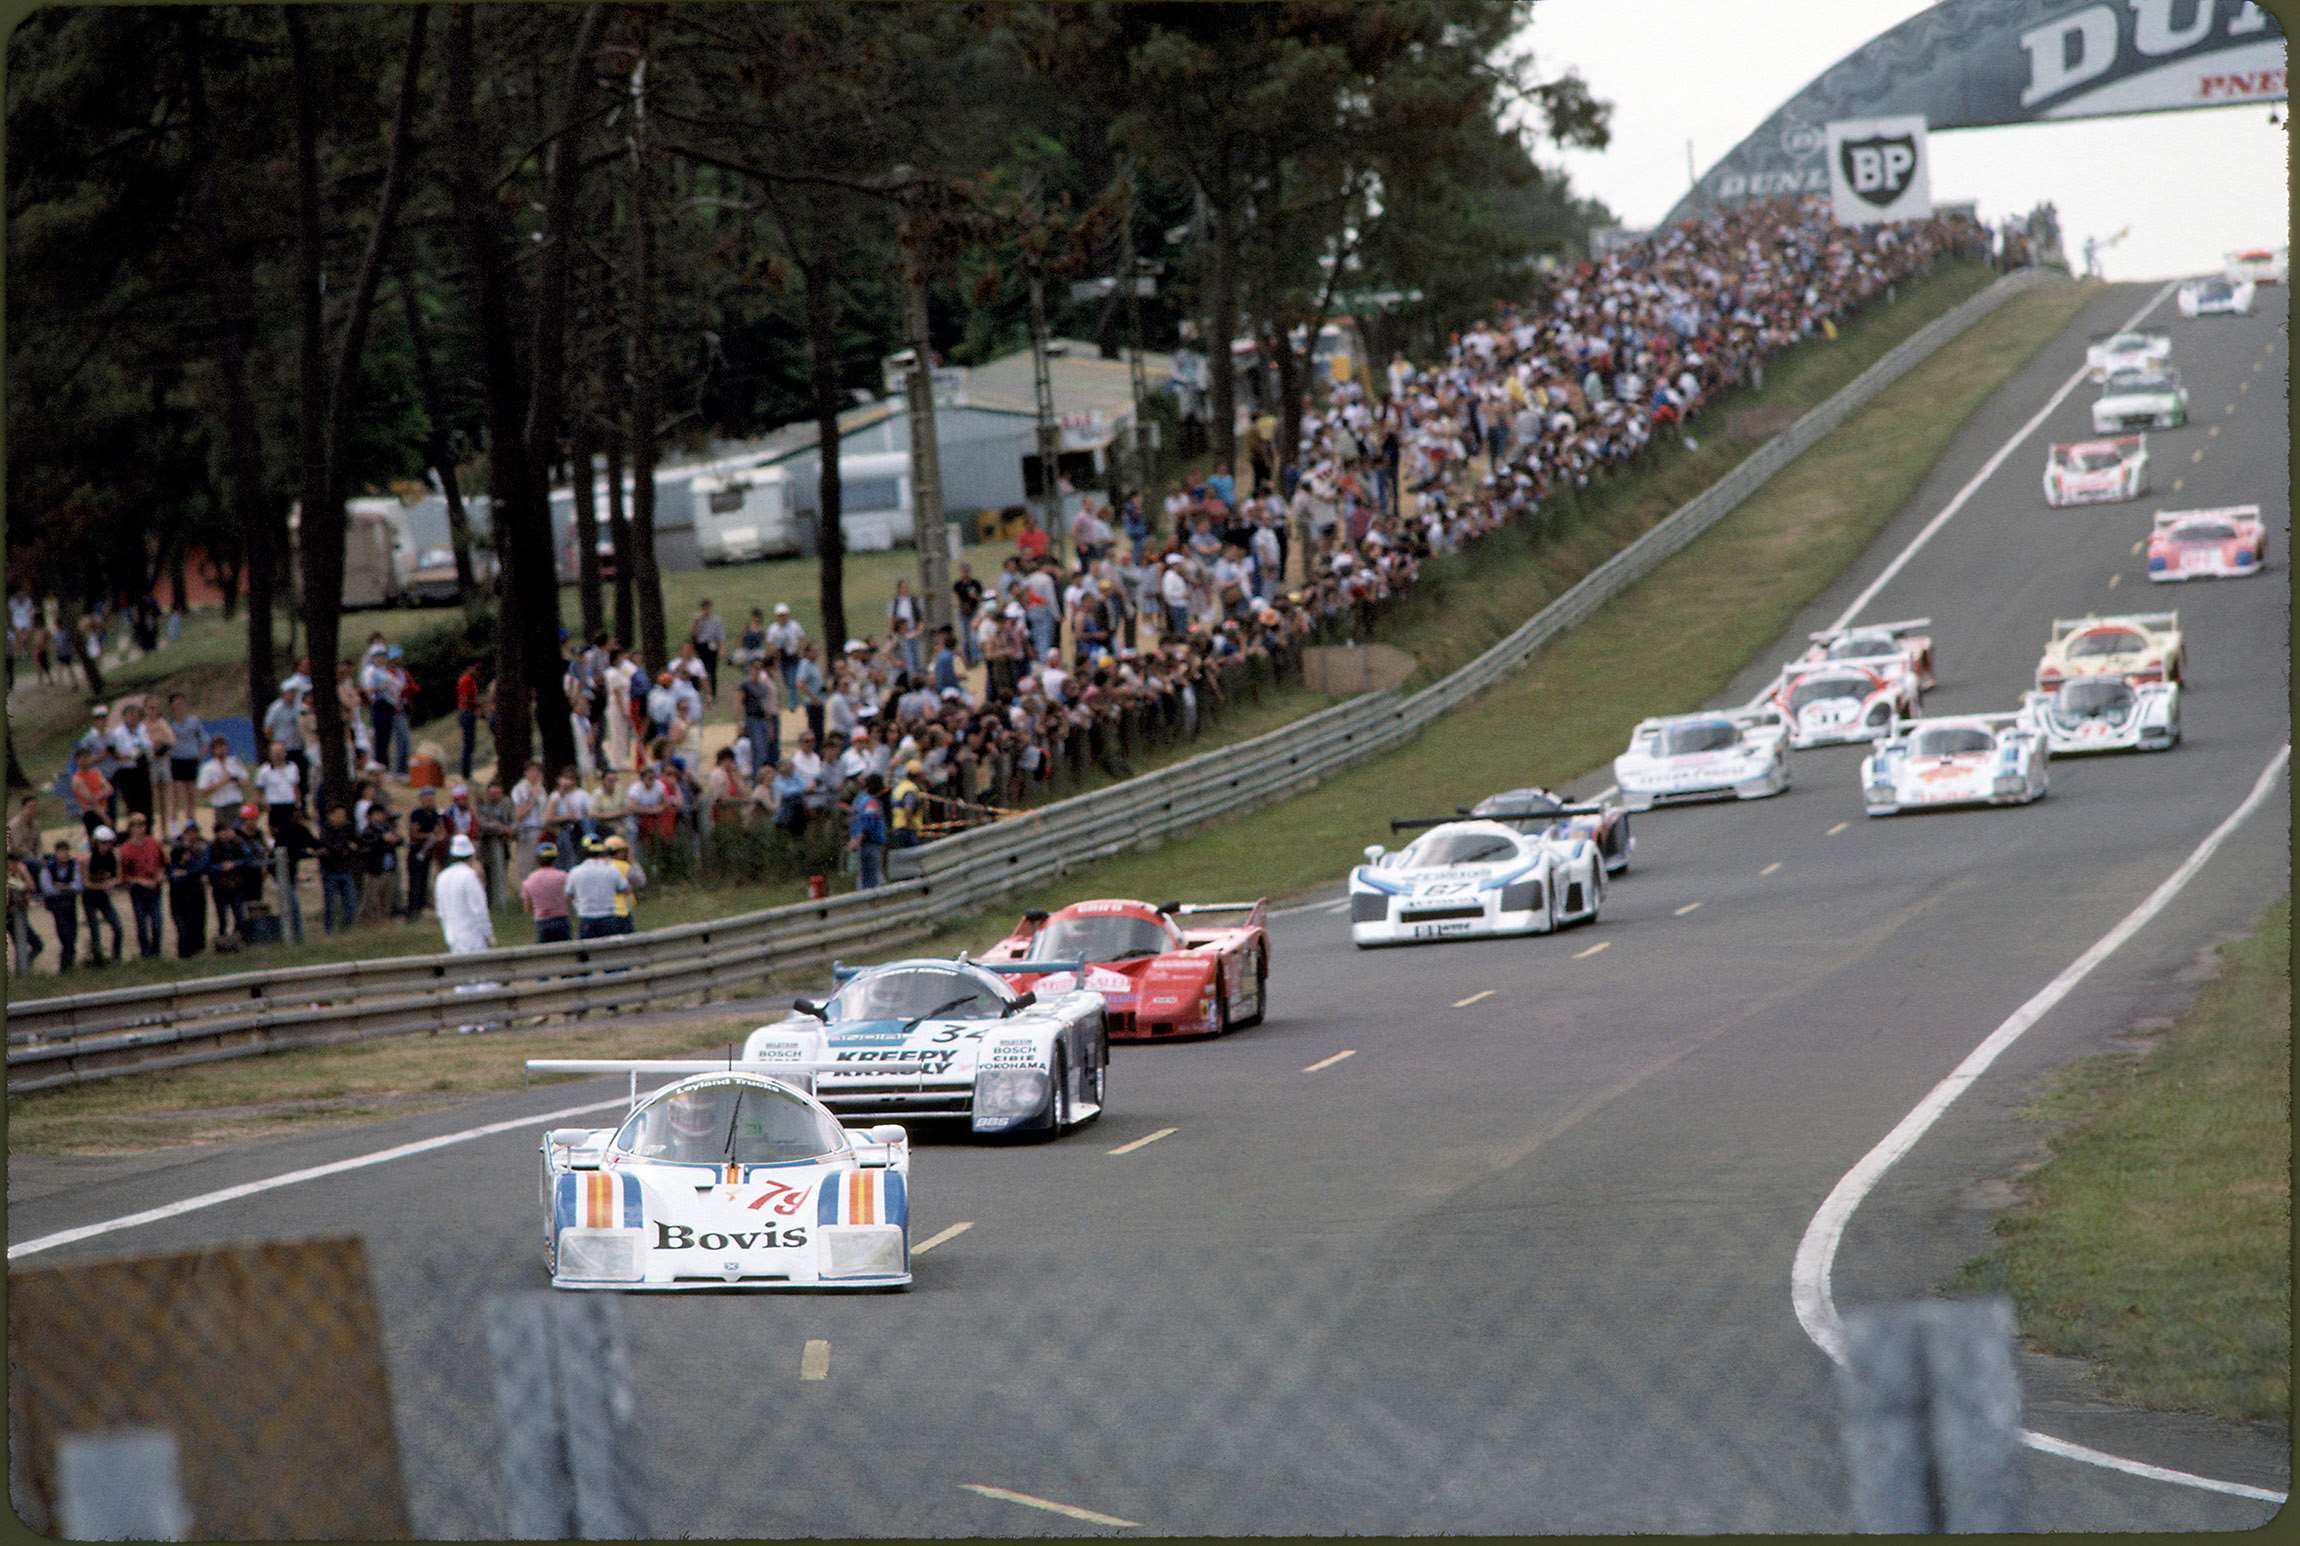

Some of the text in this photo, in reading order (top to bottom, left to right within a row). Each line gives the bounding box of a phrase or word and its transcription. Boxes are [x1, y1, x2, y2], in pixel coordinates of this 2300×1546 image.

[2019, 0, 2267, 108] DU
[1851, 143, 1914, 194] BP
[759, 1049, 802, 1058] BOSCH
[836, 1050, 958, 1061] KREEPY
[993, 1046, 1037, 1055] BOSCH
[979, 1062, 1047, 1070] YOKOHAMA
[676, 1078, 780, 1094] Leyland Trucks
[747, 1180, 813, 1216] 79
[653, 1220, 809, 1250] Bovis
